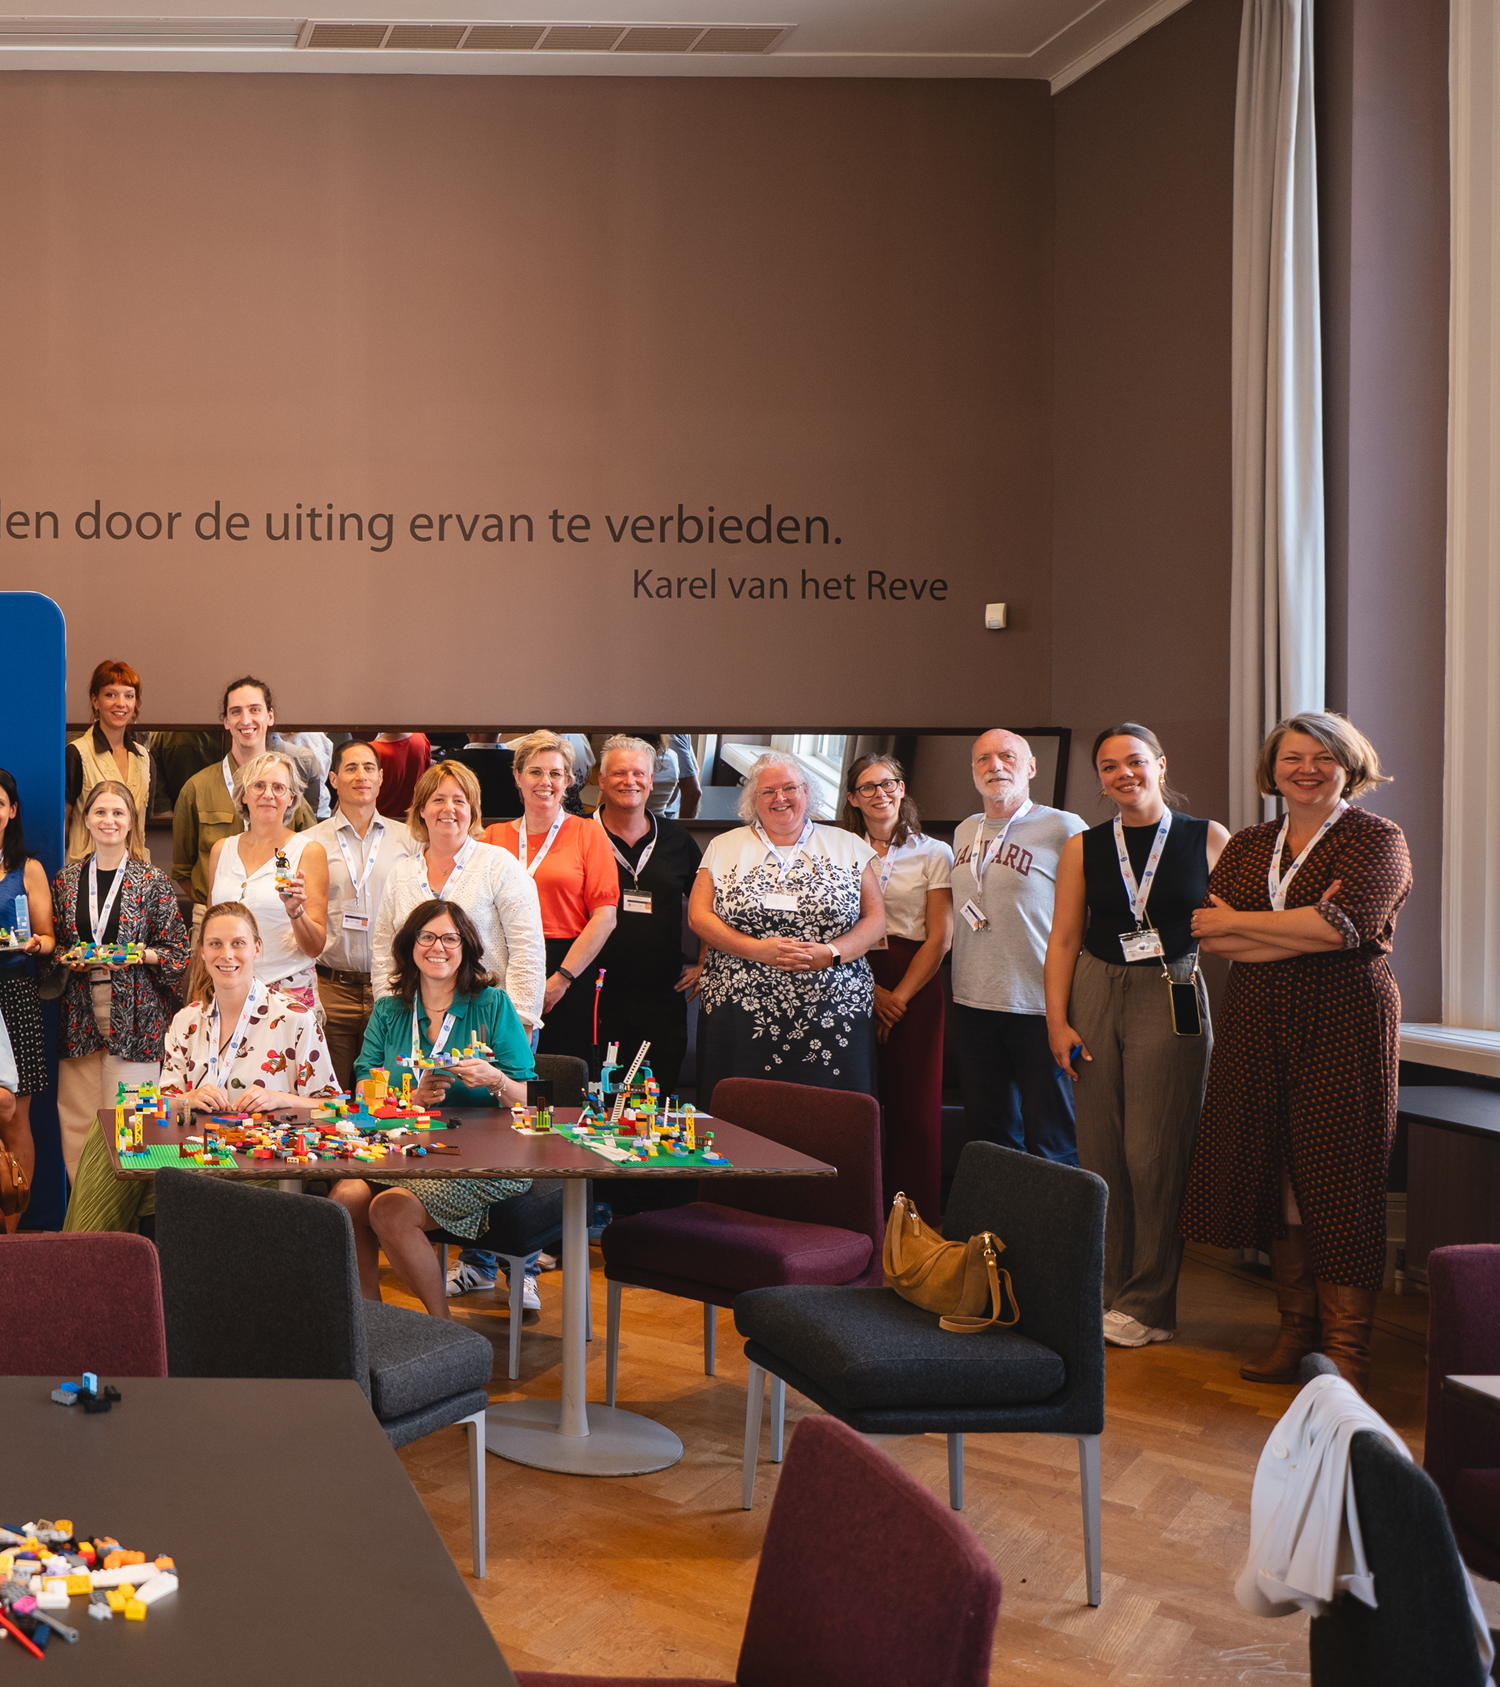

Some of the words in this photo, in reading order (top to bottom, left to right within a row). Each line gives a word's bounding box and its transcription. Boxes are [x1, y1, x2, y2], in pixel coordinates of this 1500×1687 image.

[75, 498, 183, 541] door
[195, 499, 251, 542] de
[266, 502, 395, 554] uiting
[410, 512, 534, 543] ervan
[548, 508, 592, 544] te
[605, 503, 842, 545] verbieden.
[634, 568, 717, 600] Karel
[728, 576, 788, 600] van
[801, 569, 856, 601] het
[868, 569, 949, 602] Reve
